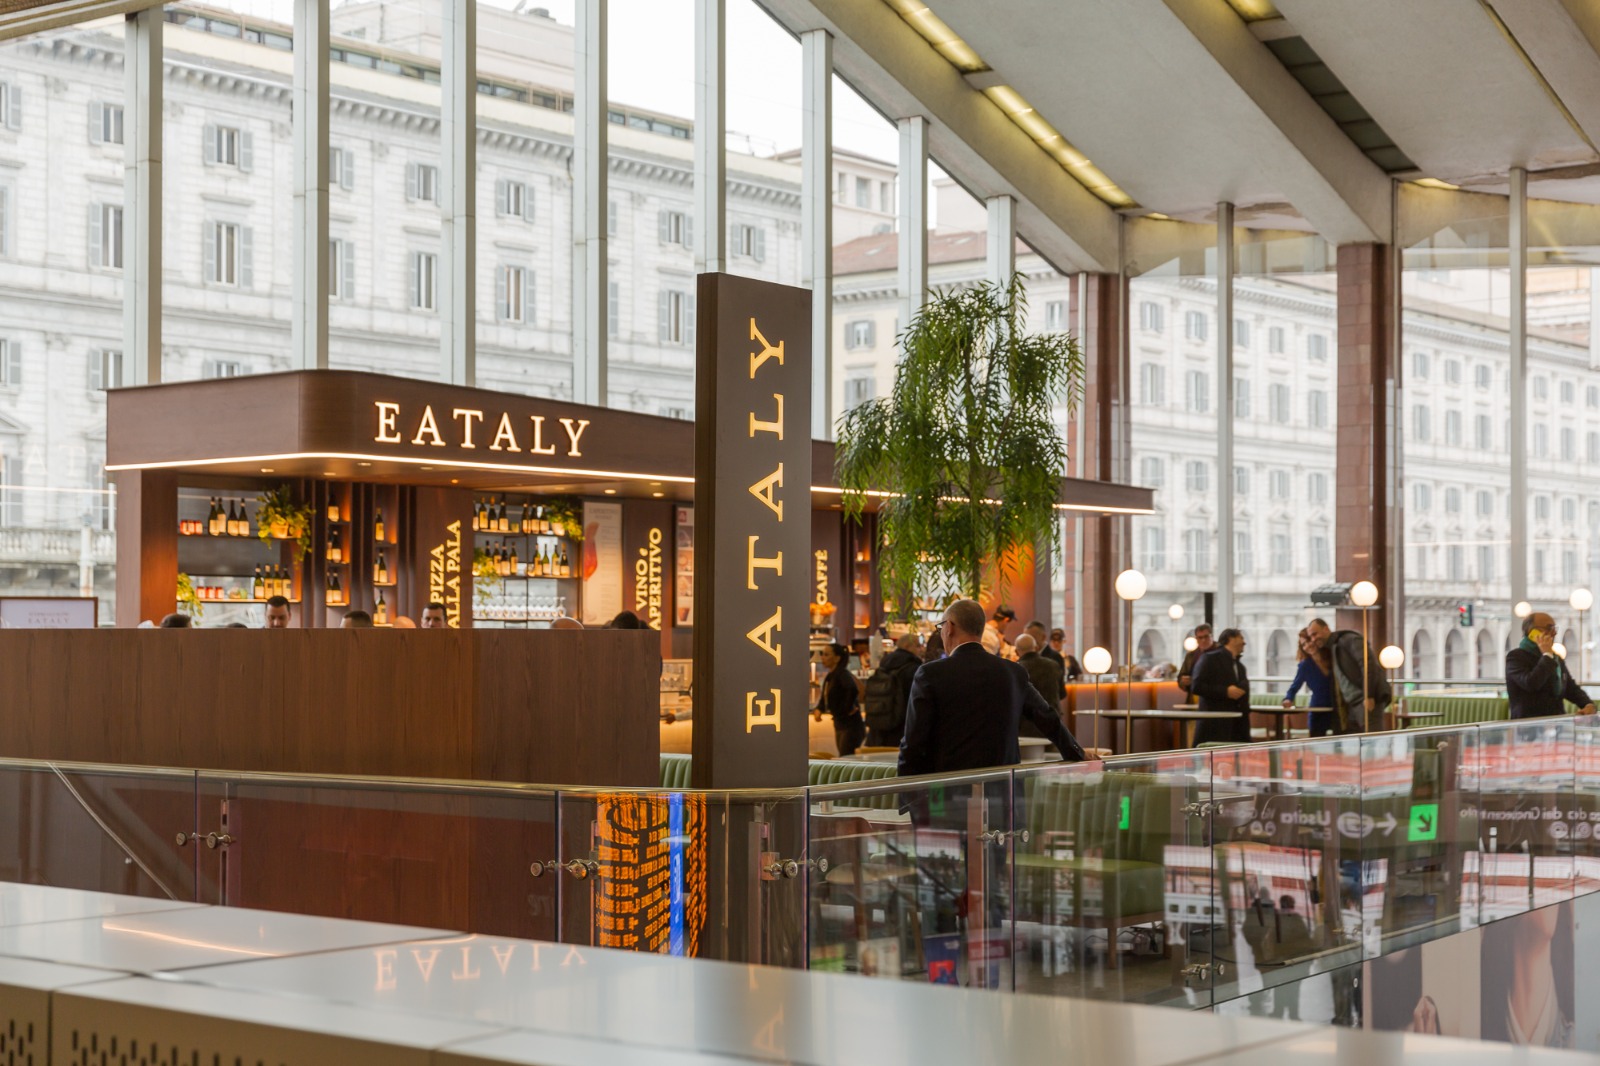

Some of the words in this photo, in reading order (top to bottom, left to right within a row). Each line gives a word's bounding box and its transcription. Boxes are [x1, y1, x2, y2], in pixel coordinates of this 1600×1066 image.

[373, 401, 591, 457] EATALY
[446, 519, 462, 573] PALA
[746, 317, 785, 734] EATALY
[429, 543, 445, 605] PIZZA
[446, 575, 461, 628] ALLA
[635, 558, 649, 612] VINO
[648, 527, 663, 631] APERITIVO
